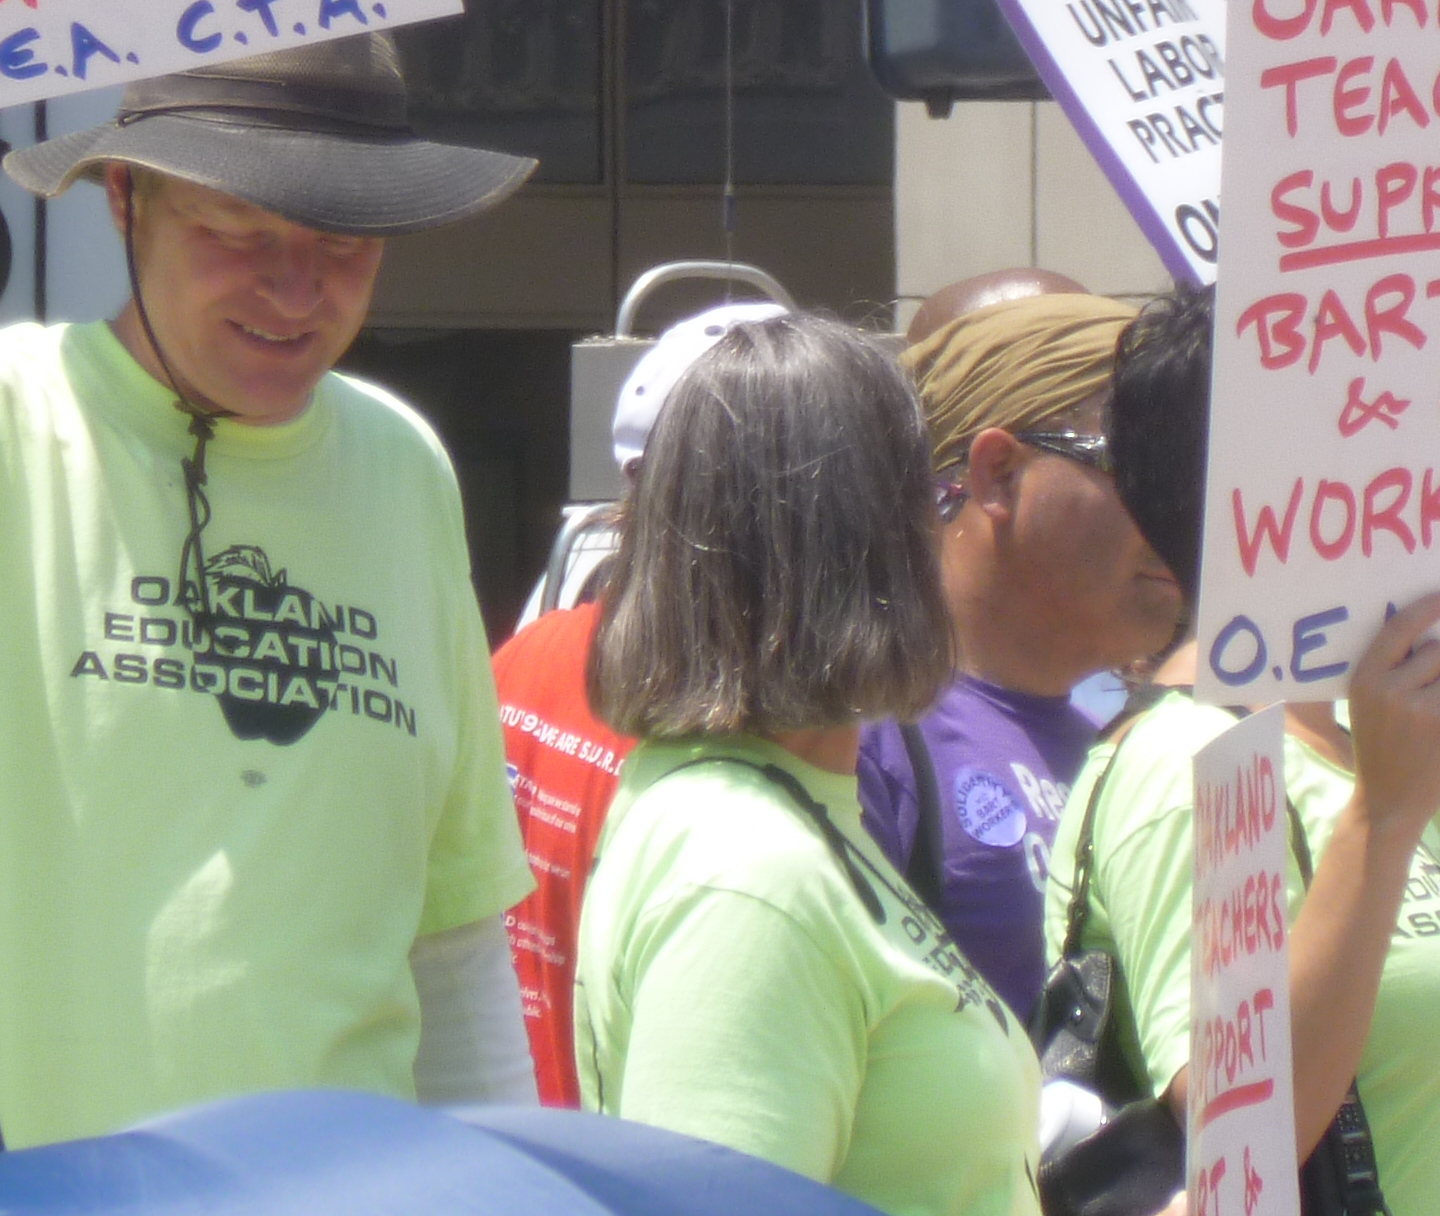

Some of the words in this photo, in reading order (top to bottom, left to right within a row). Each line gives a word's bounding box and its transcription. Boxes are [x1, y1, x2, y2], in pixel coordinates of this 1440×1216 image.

[1106, 33, 1226, 104] LABOR
[1337, 375, 1412, 439] &
[129, 575, 380, 641] OAKLAND
[103, 611, 399, 689] EDUCATION
[68, 649, 419, 738] ASSOCIATION
